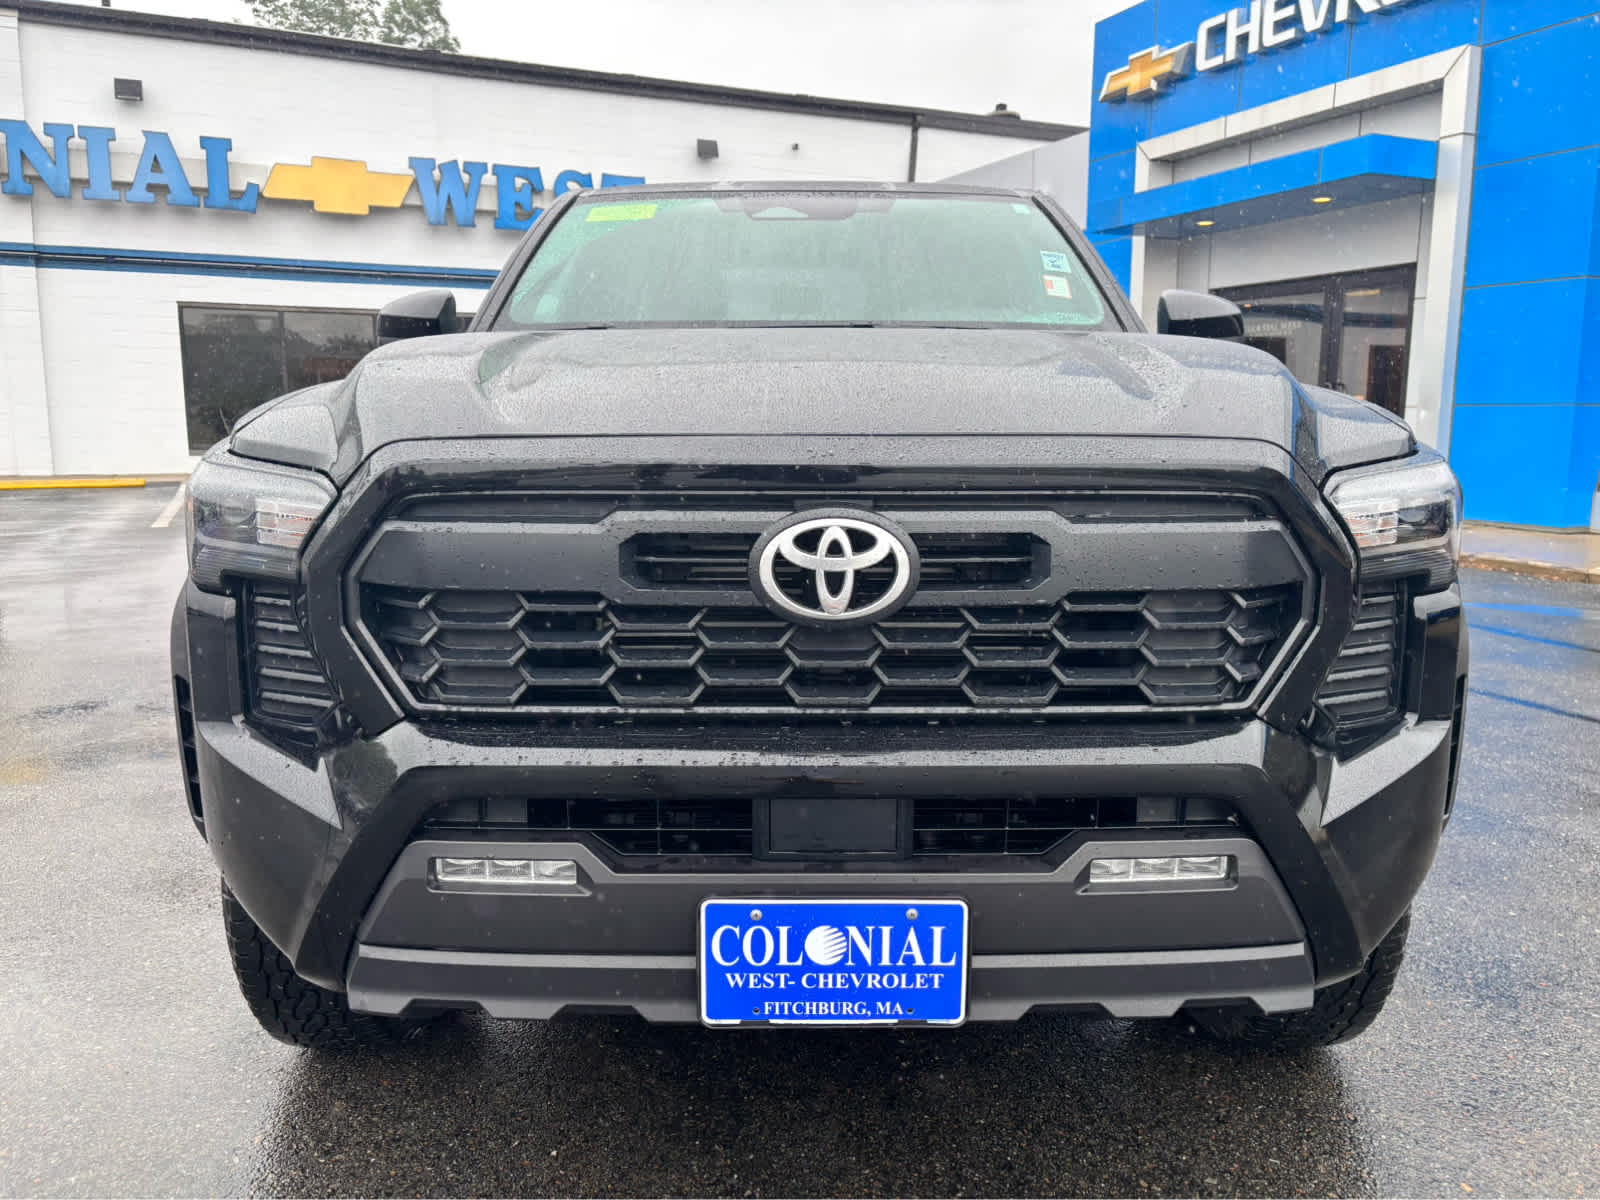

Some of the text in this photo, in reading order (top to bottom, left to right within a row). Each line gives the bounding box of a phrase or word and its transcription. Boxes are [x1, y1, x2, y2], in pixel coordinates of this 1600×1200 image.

[1195, 0, 1401, 72] CHEV
[0, 118, 646, 231] NIAL WE
[711, 925, 957, 967] COLONIAL
[725, 972, 945, 989] WEST- CHEVROLET
[764, 1001, 904, 1017] FITCHBURG, MA
